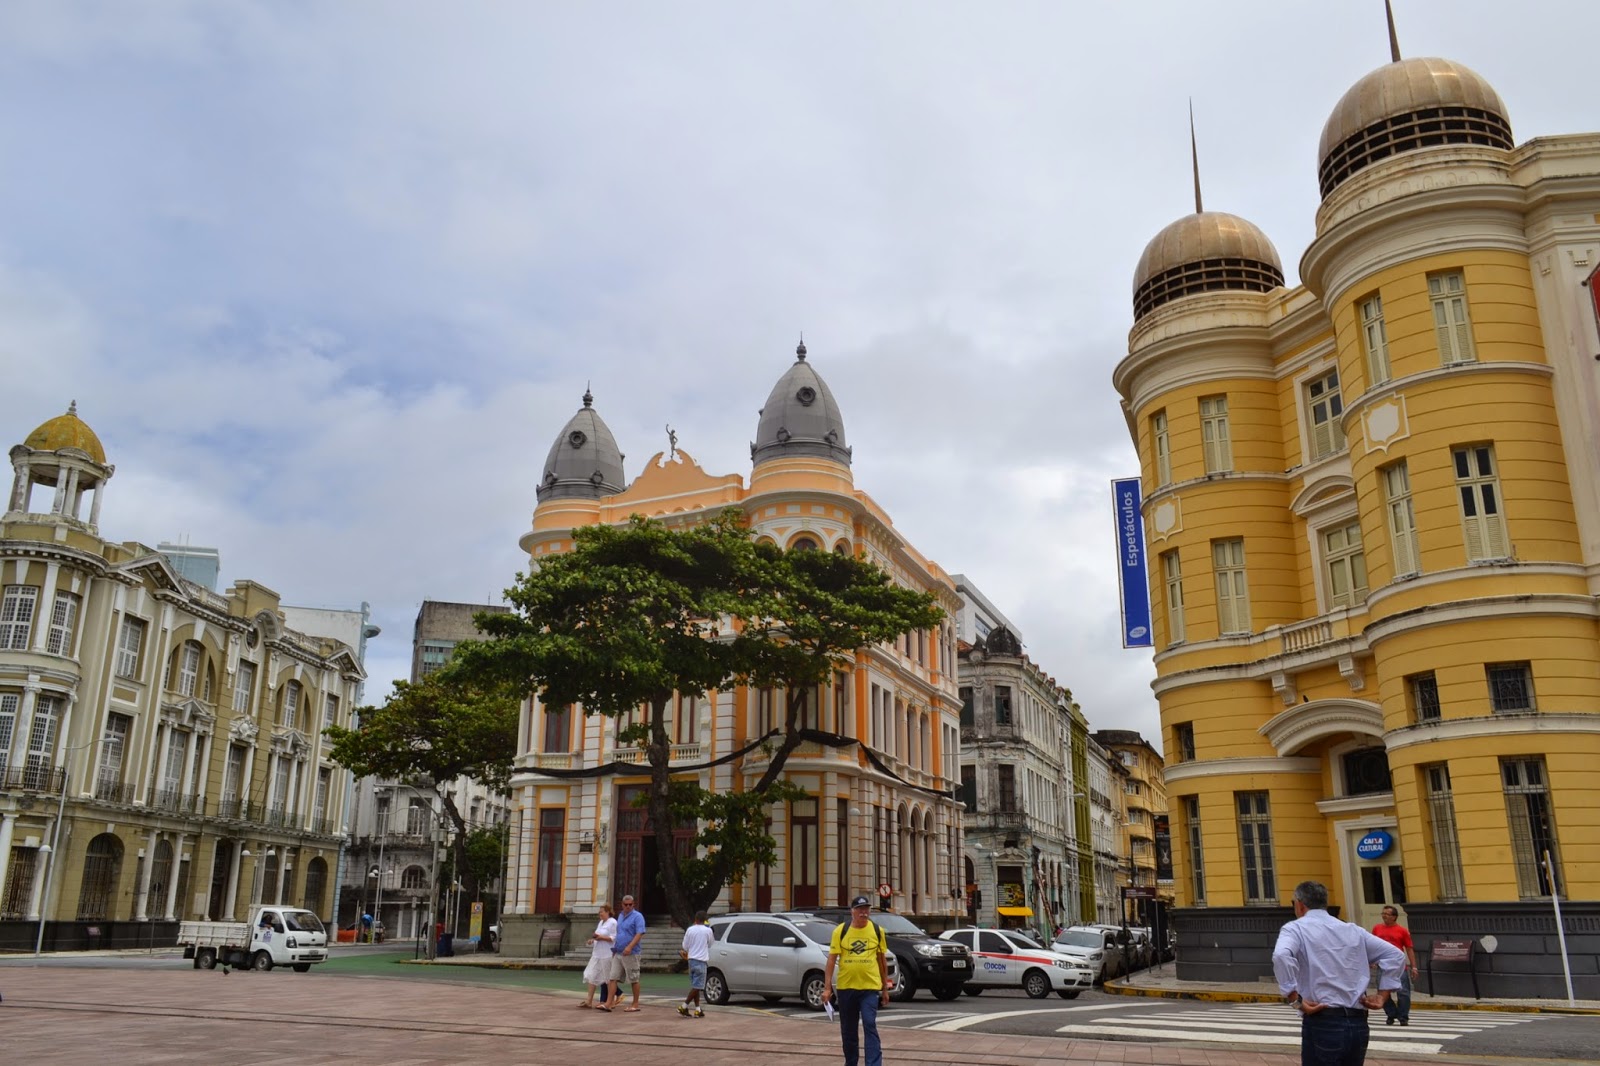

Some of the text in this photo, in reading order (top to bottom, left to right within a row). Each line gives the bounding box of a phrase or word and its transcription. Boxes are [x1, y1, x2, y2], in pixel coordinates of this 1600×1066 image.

[1122, 491, 1139, 567] Espetáculos
[1363, 837, 1384, 845] CAIXA
[1358, 844, 1384, 852] CULTURAL
